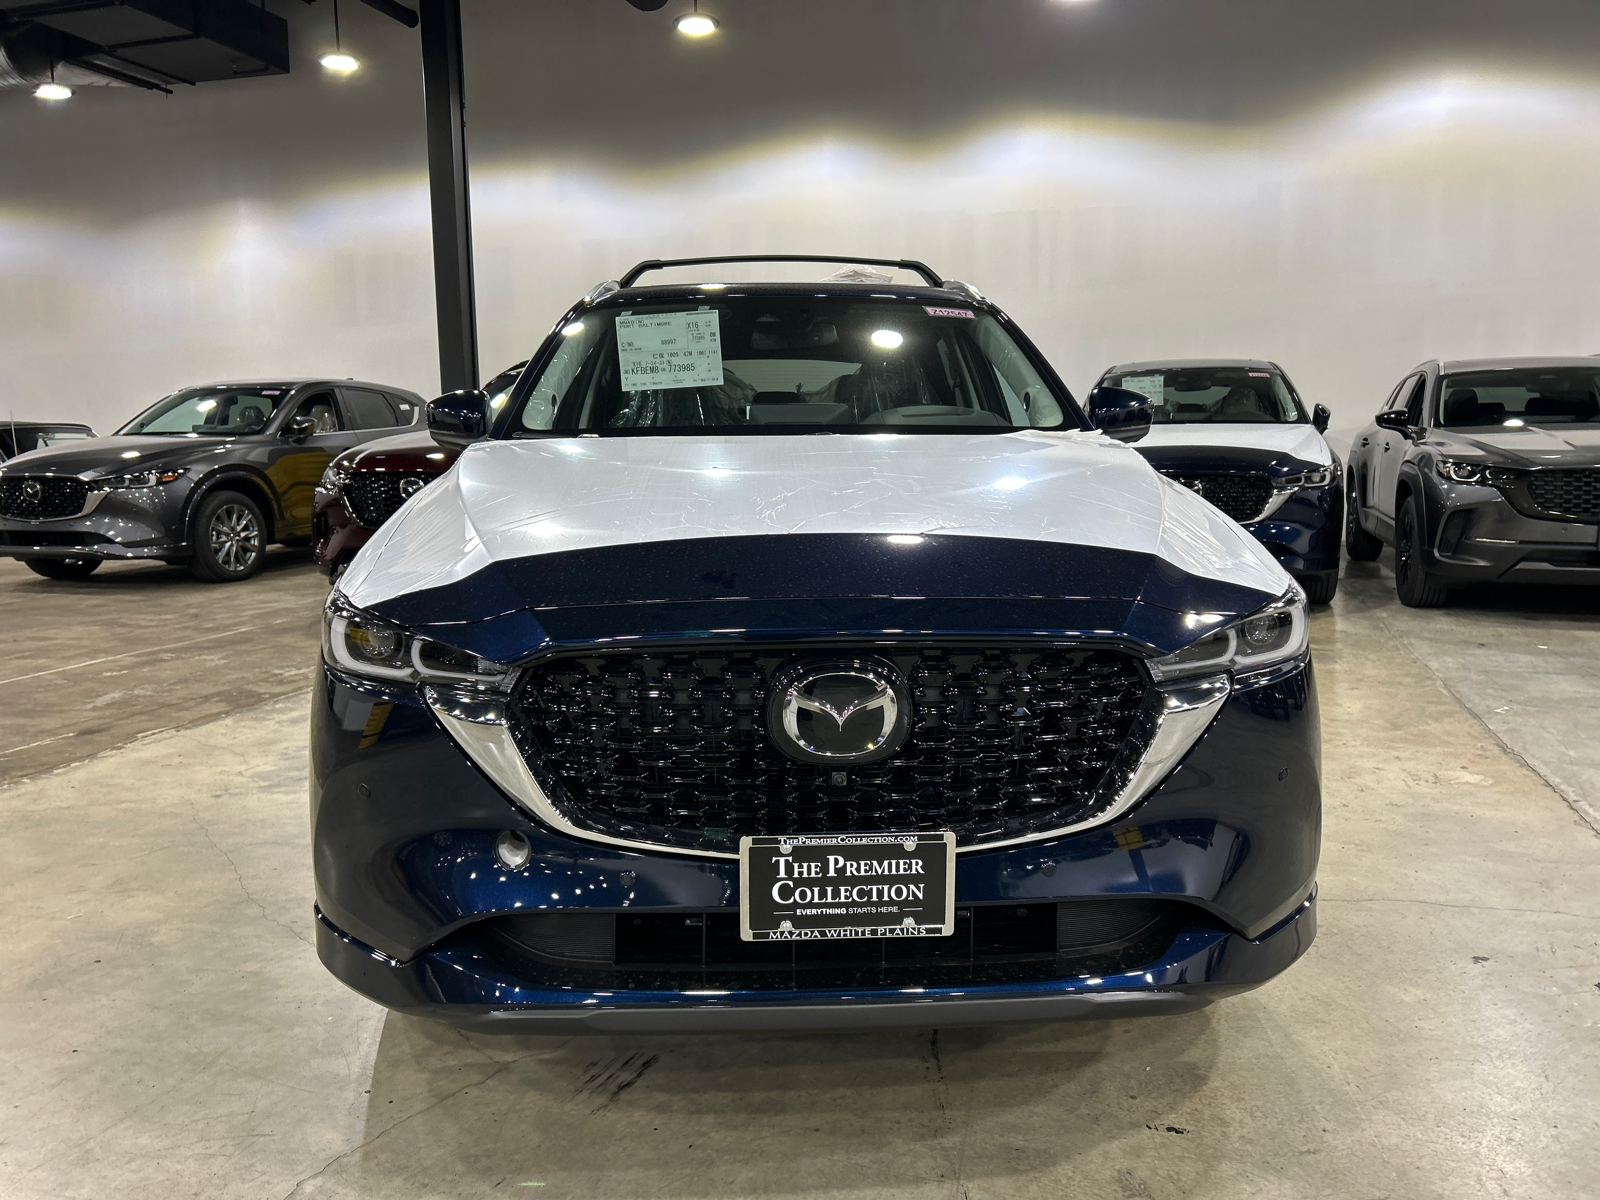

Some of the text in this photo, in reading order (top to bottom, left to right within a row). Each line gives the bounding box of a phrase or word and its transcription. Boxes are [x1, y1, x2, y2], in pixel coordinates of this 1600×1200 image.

[668, 363, 696, 373] 773985
[772, 855, 925, 878] THE PREMIER
[771, 881, 925, 904] COLLECTION
[796, 907, 847, 915] EVERYTHING
[877, 906, 900, 914] HERE.
[769, 927, 927, 939] MAZDA WHITE PLAINS
